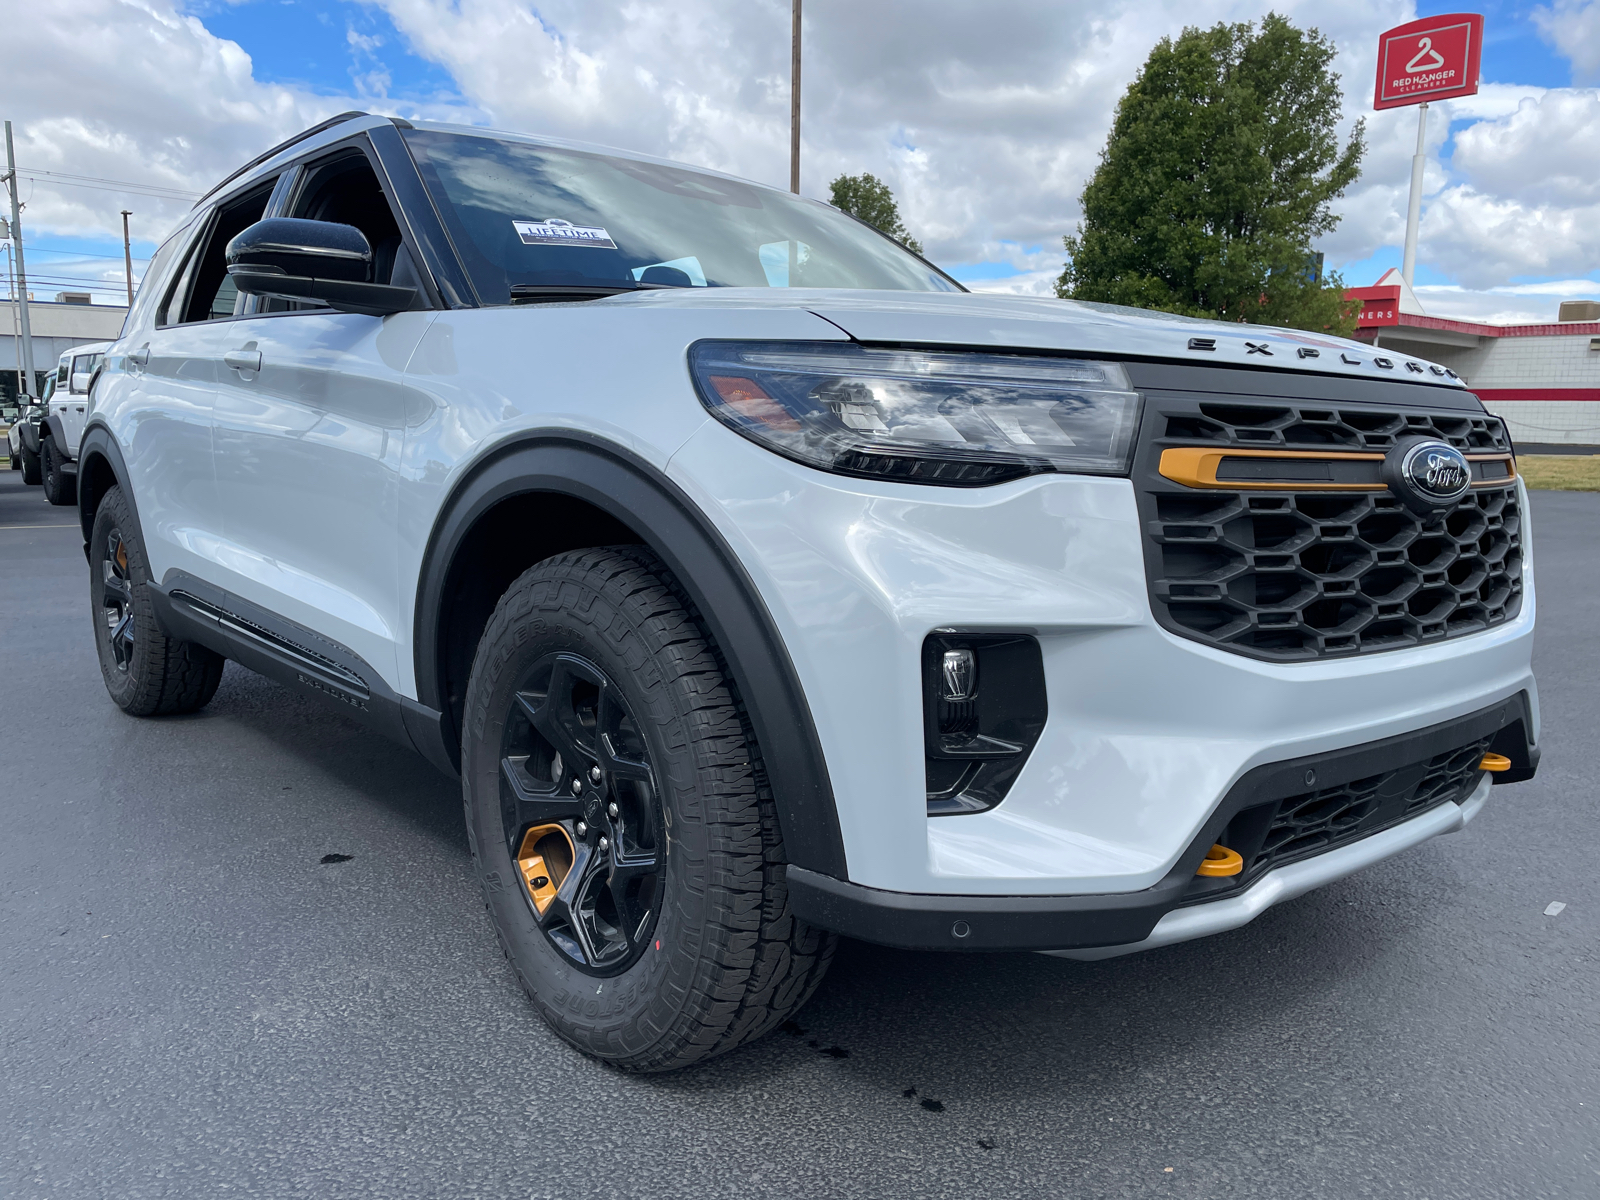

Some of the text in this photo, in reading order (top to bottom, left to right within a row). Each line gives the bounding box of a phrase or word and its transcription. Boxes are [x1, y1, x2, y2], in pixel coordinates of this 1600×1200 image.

[1392, 69, 1455, 88] RED HANGER
[1400, 79, 1446, 92] CLEANERS
[527, 227, 601, 239] LIFETIME
[1349, 310, 1393, 320] NERS
[1186, 336, 1459, 379] EXPLORER
[1426, 453, 1463, 488] Ford
[296, 673, 369, 712] EXPLORER
[474, 617, 547, 741] DUELER
